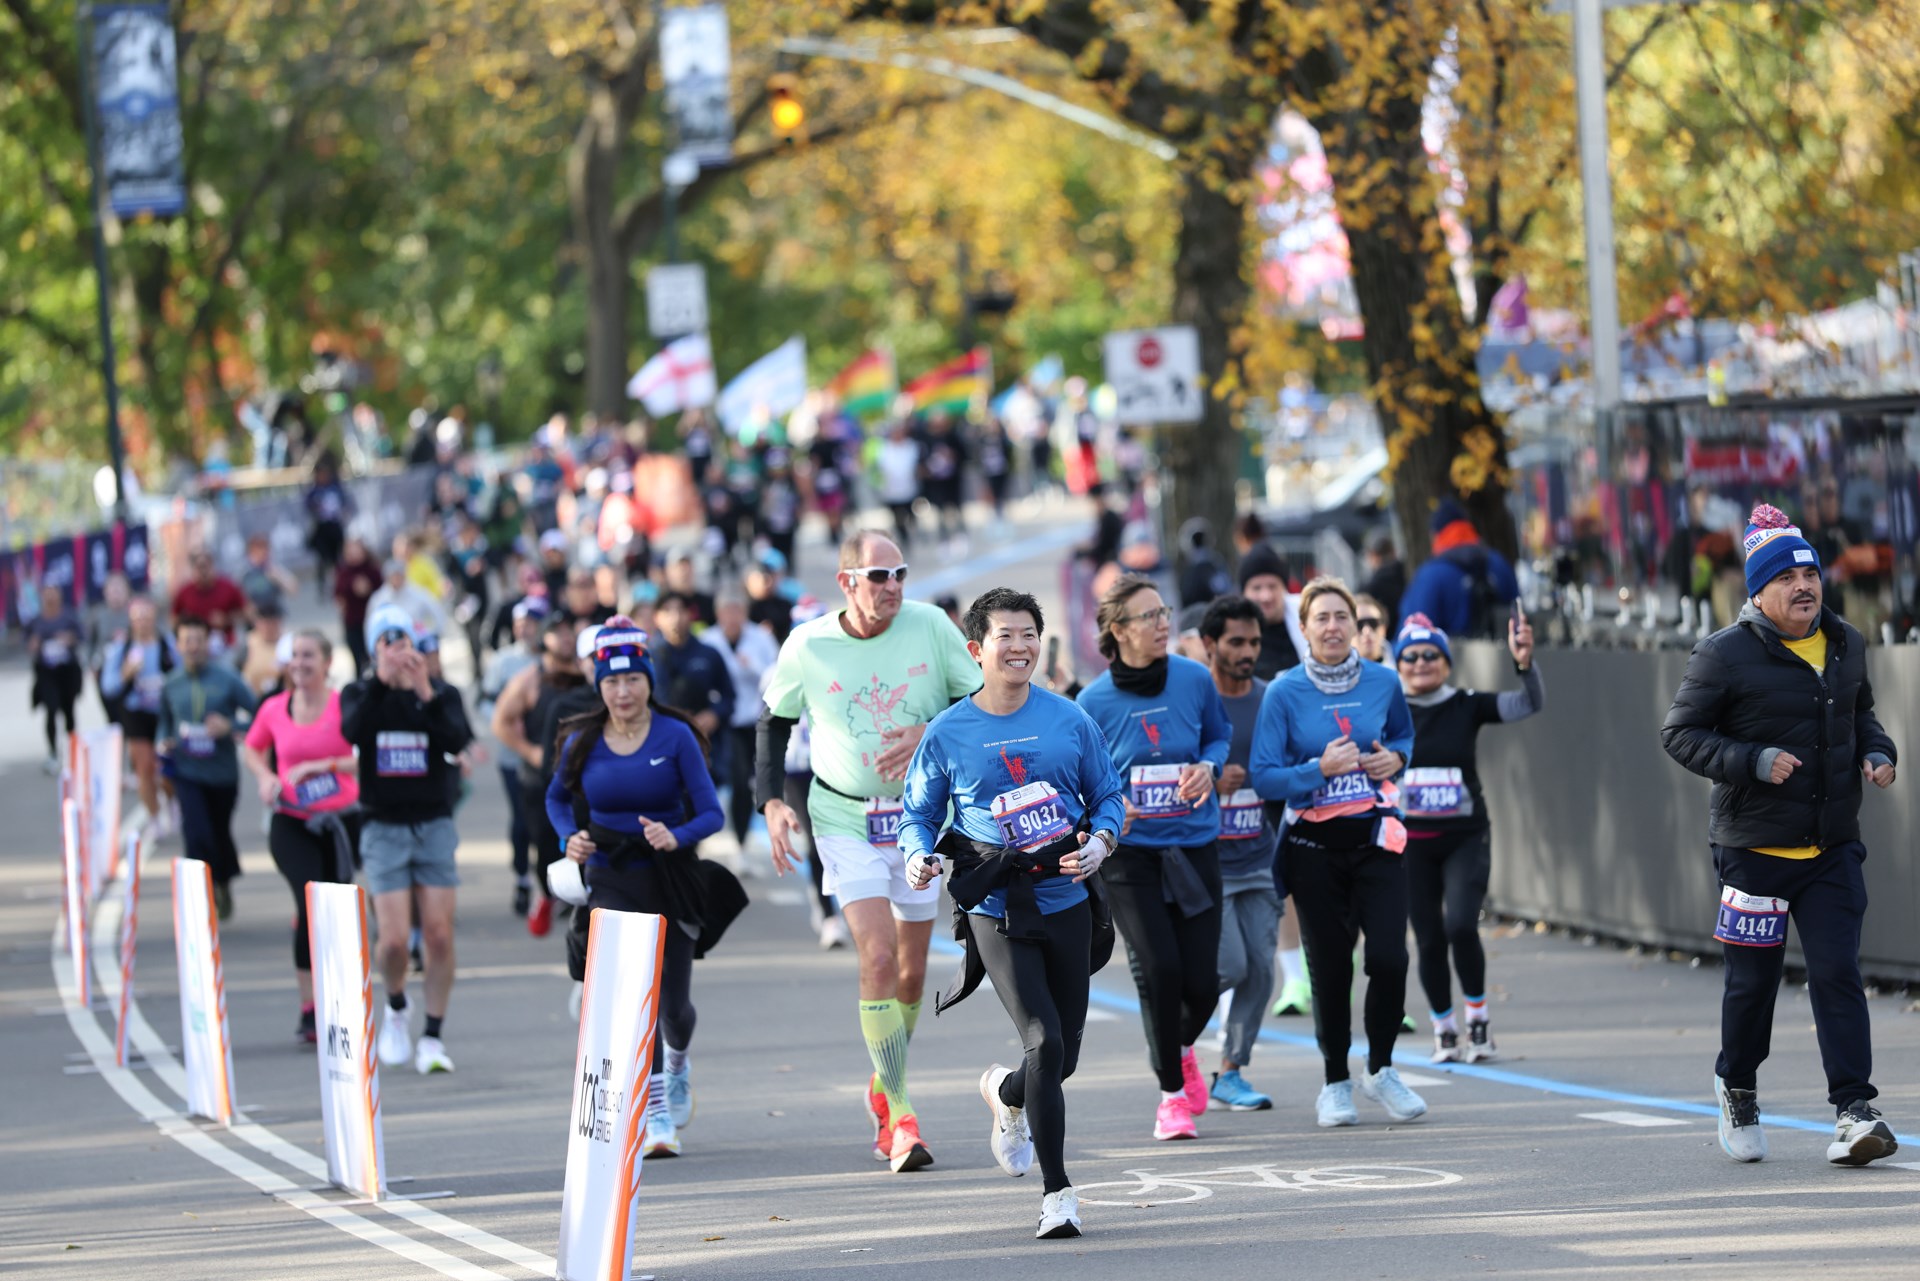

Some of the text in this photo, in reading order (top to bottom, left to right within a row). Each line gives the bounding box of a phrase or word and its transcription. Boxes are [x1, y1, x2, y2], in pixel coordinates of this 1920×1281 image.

[1145, 786, 1189, 808] 1224
[1327, 773, 1371, 798] 12251
[870, 819, 879, 835] L
[1003, 821, 1018, 842] I
[1019, 803, 1060, 836] 9031
[1720, 909, 1728, 929] L
[1735, 915, 1778, 937] 4147
[860, 1003, 890, 1011] cep
